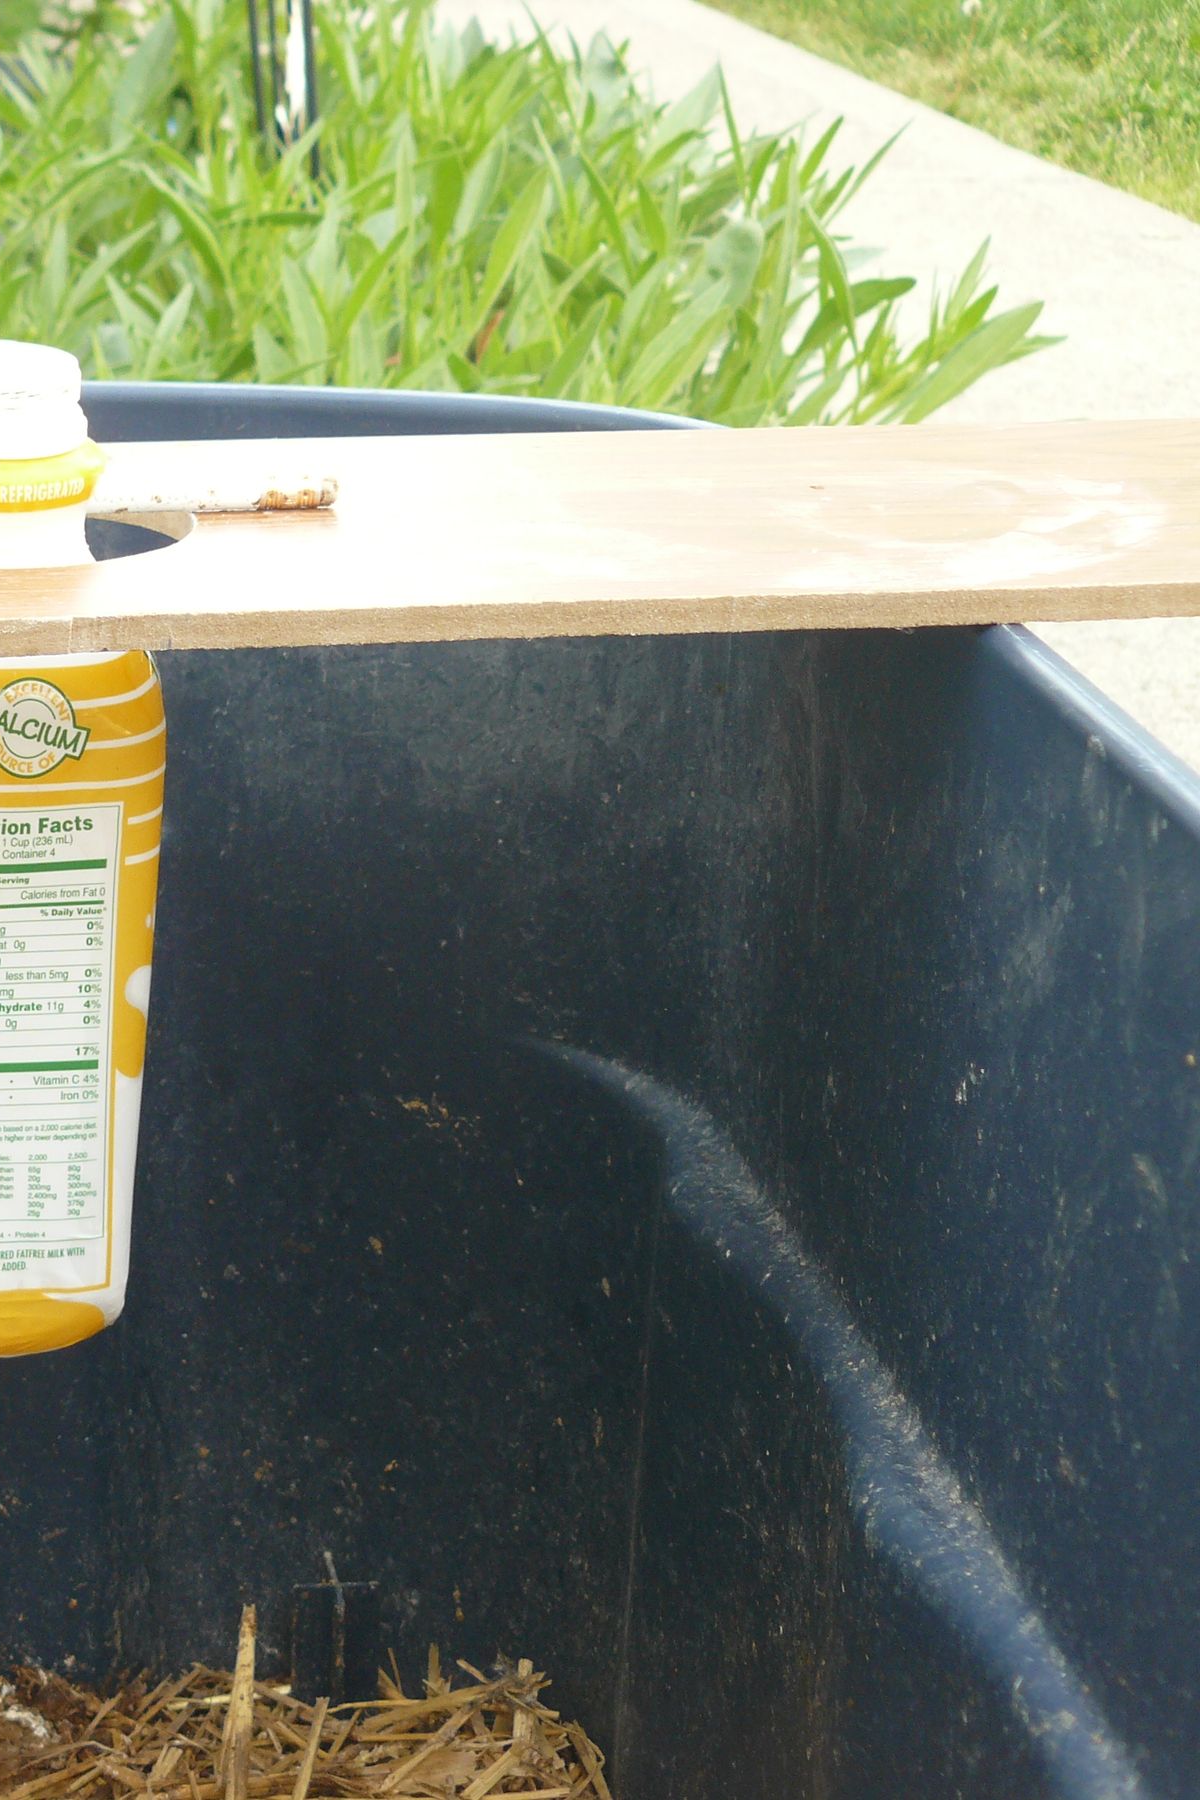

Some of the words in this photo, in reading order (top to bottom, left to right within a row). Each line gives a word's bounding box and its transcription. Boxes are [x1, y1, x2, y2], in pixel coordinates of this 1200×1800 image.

[0, 478, 84, 503] REFRIGERATED
[5, 683, 70, 721] EXCELLENT
[39, 752, 56, 768] OF
[38, 816, 93, 833] Facts
[3, 838, 6, 847] 1
[11, 837, 29, 848] Cup
[32, 836, 52, 848] (236
[56, 835, 73, 845] mL)
[2, 849, 46, 859] Container
[50, 848, 55, 856] 4
[21, 890, 57, 900] Calories
[60, 889, 80, 897] from
[83, 888, 97, 897] Fat
[100, 888, 105, 896] 0
[52, 909, 73, 917] Daily
[87, 922, 103, 930] 0%
[14, 940, 25, 951] 0g
[86, 937, 103, 946] 0%
[6, 972, 23, 980] less
[27, 971, 46, 980] than
[50, 970, 68, 981] 5mg
[85, 969, 102, 977] 0%
[78, 985, 101, 993] 10%
[47, 1002, 64, 1012] 11g
[83, 1000, 101, 1008] 4%
[5, 1018, 17, 1030] 0g
[83, 1016, 100, 1024] 0%
[33, 1075, 69, 1085] Vitamin
[72, 1075, 80, 1083] C
[83, 1074, 99, 1083] 4%
[60, 1091, 79, 1100] Iron
[82, 1090, 99, 1099] 0%
[5, 1134, 23, 1142] higher
[34, 1133, 51, 1141] lower
[53, 1132, 87, 1142] depending
[68, 1152, 88, 1160] 2,500
[28, 1166, 40, 1174] 65g
[16, 1249, 45, 1259] FATFREE
[48, 1249, 64, 1258] MILK
[67, 1248, 85, 1256] WITH
